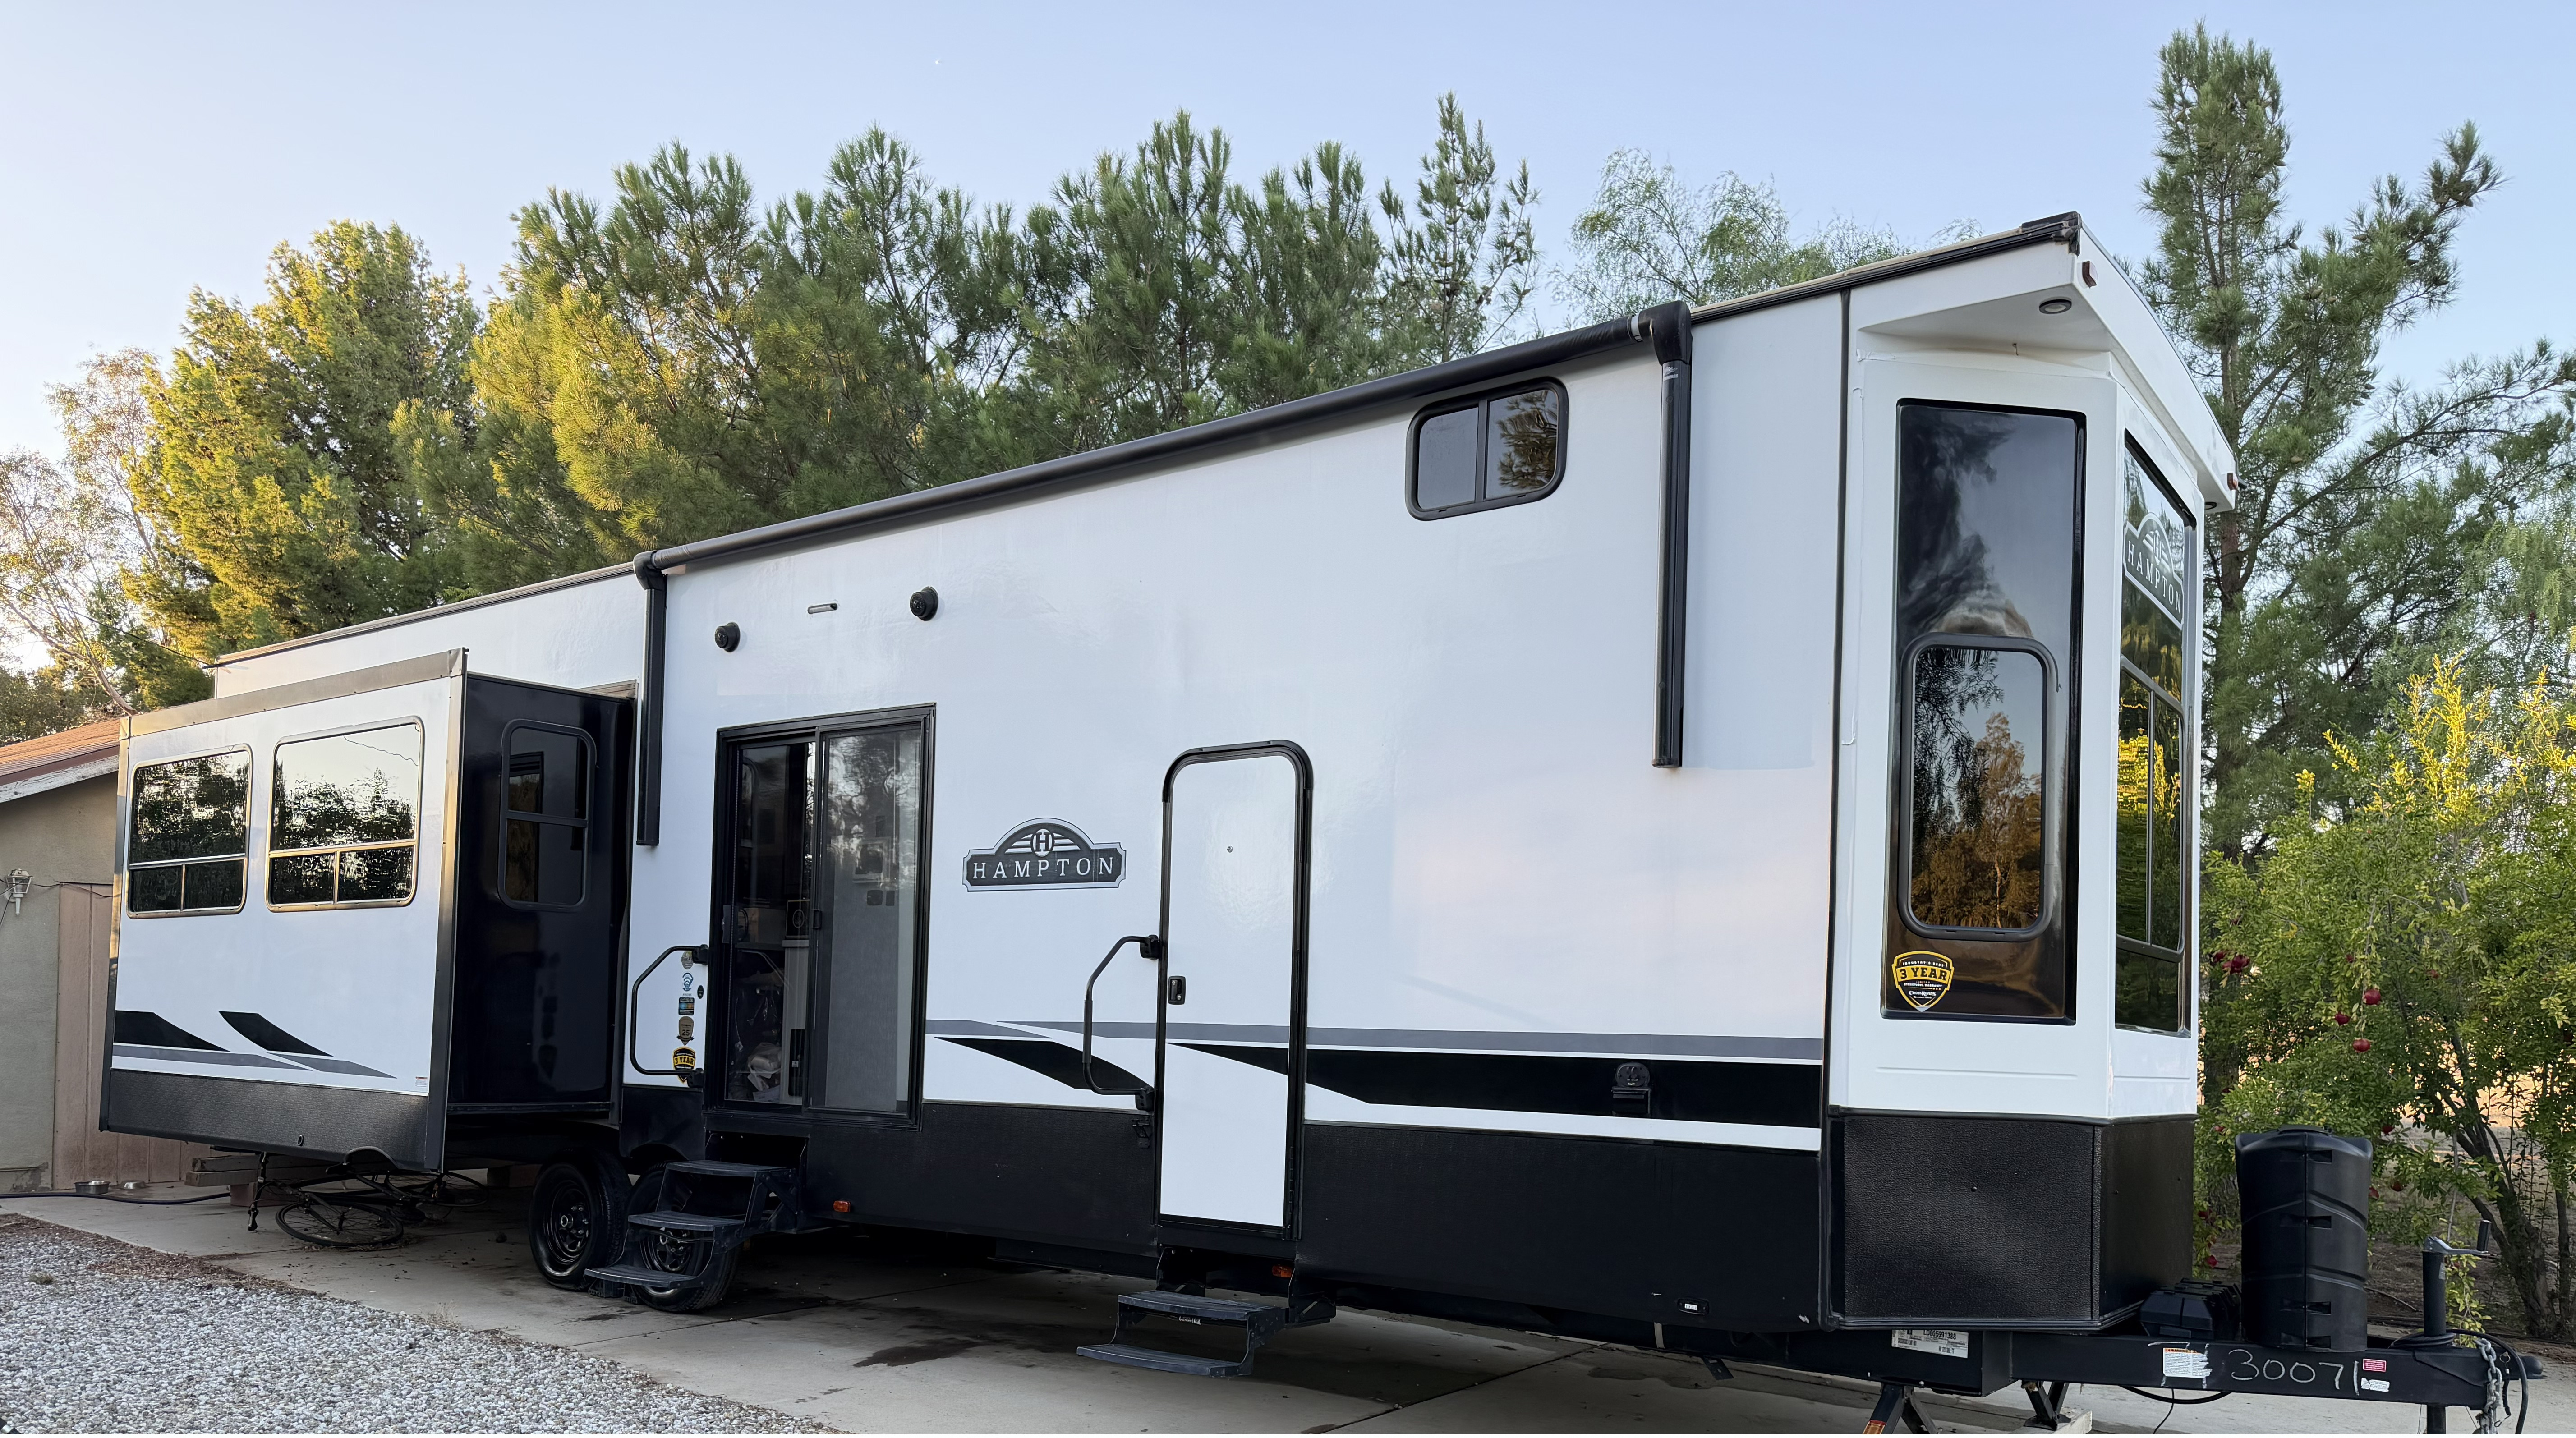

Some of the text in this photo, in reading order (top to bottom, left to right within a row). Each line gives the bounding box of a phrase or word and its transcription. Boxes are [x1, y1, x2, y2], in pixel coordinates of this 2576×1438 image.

[2128, 540, 2181, 614] HAMPTON
[973, 857, 1113, 879] HAMPTON
[1899, 967, 1947, 981] 3 YEAR
[679, 1057, 694, 1065] YEAR
[2228, 1349, 2360, 1396] 30071
